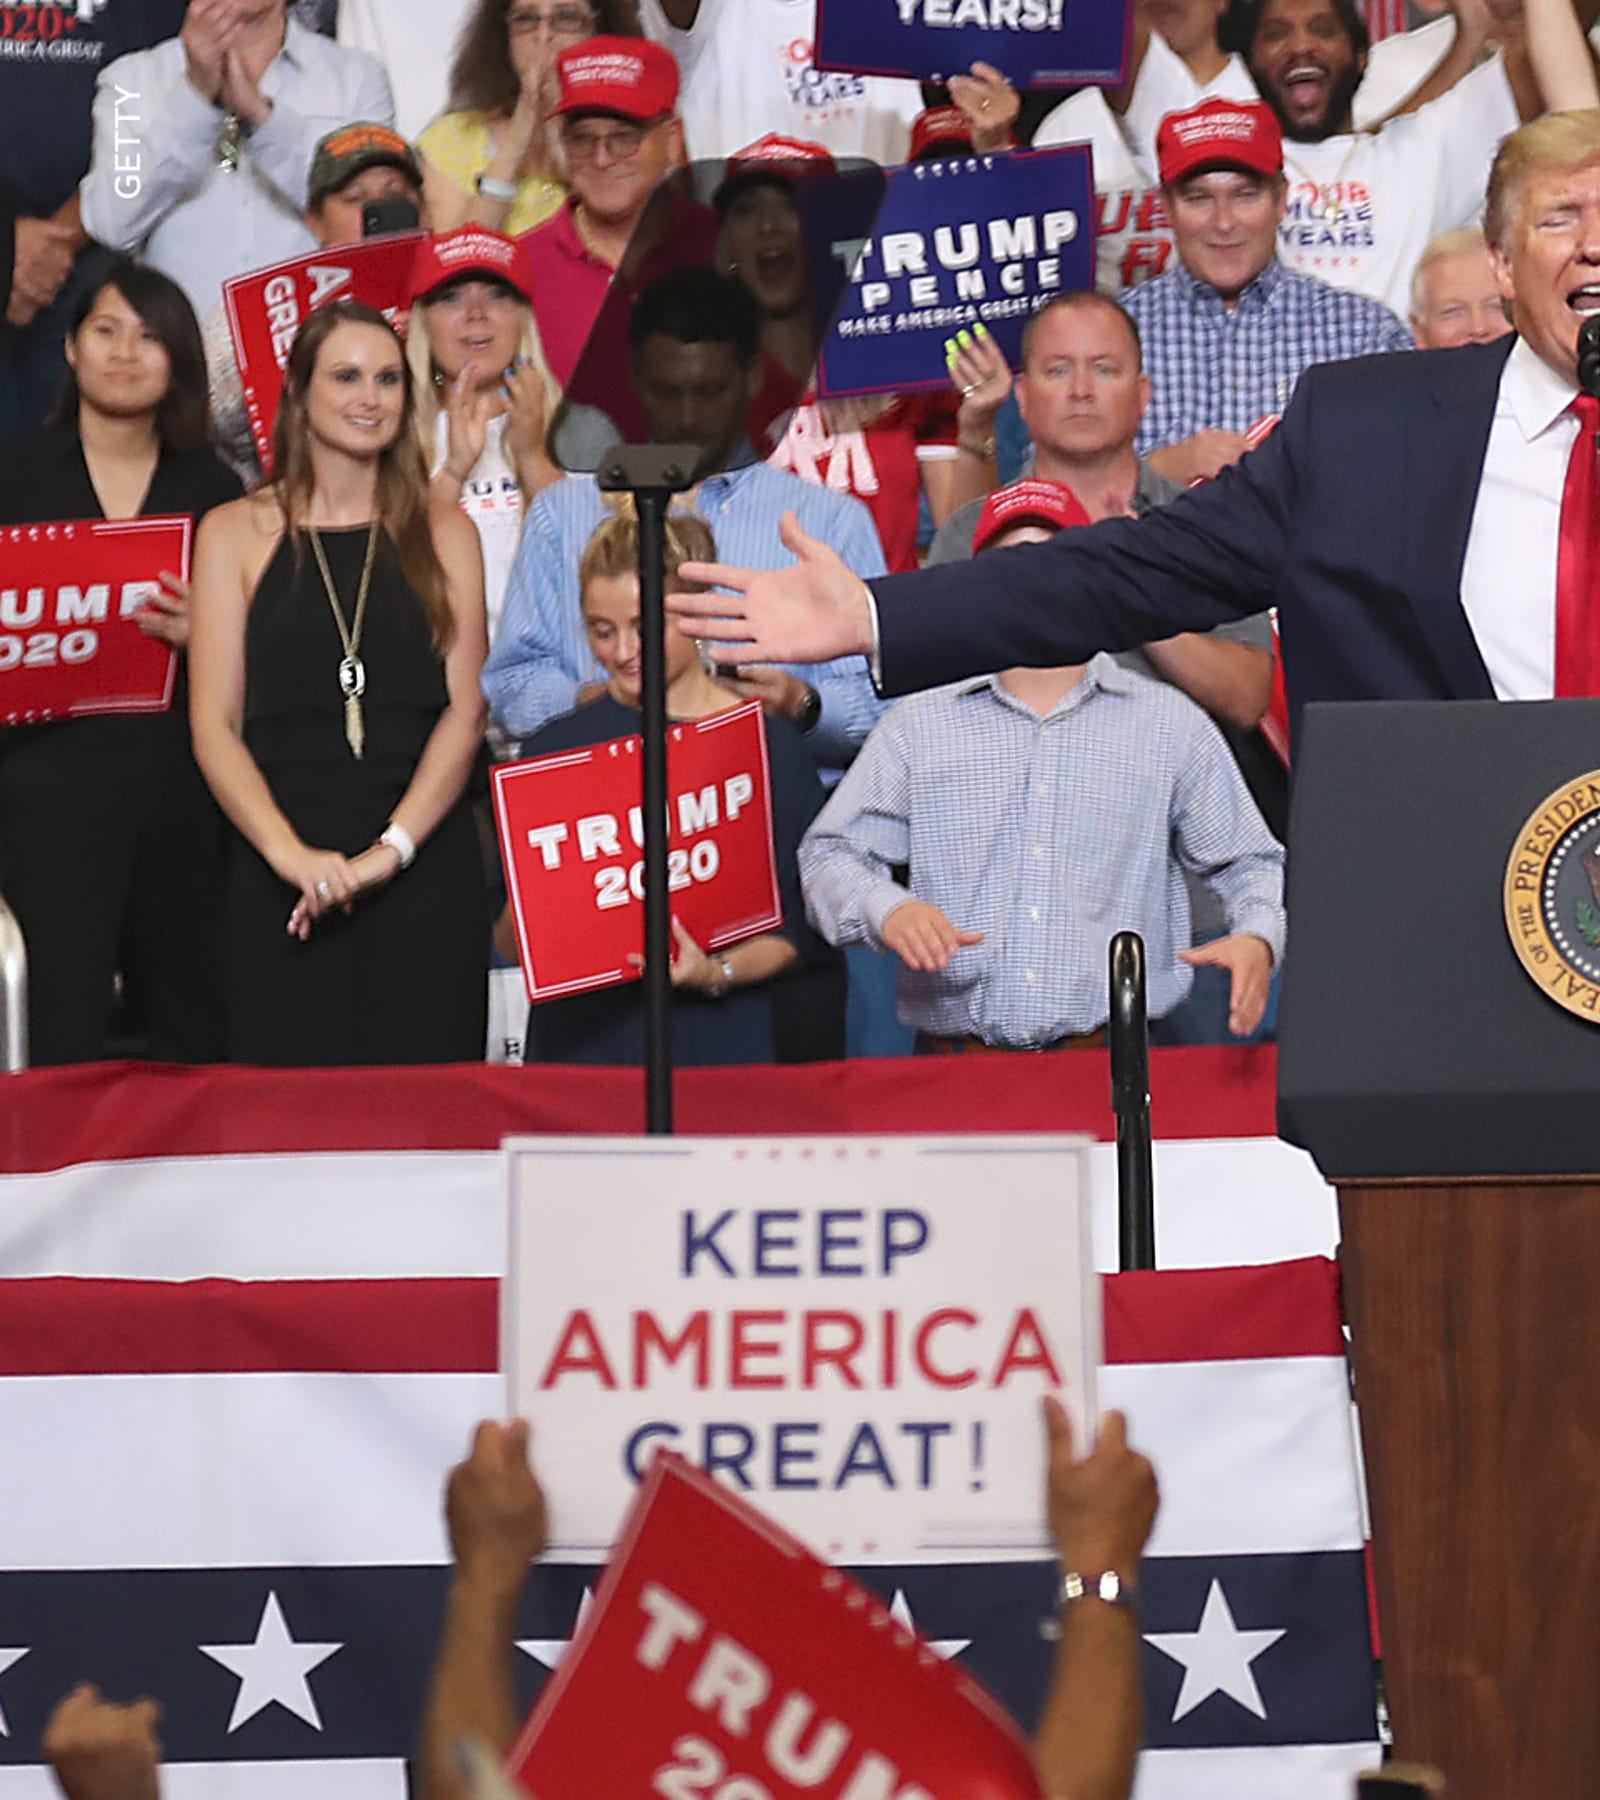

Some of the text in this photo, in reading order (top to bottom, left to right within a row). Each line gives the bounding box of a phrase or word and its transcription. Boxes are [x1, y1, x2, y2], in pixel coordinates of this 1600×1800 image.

[0, 4, 62, 41] 020
[896, 0, 1063, 31] YEARS!
[831, 210, 1079, 284] TRUMP
[860, 258, 1061, 313] PENCE
[264, 275, 302, 370] GRE
[837, 313, 891, 339] MAKE
[893, 304, 978, 333] AMERICA
[979, 296, 1030, 321] GREAT
[0, 580, 162, 630] UMP
[0, 628, 99, 672] 020
[1517, 903, 1539, 937] THE
[1529, 943, 1549, 965] OF
[679, 1208, 932, 1279] KEEP
[538, 1308, 1063, 1392] AMERICA
[622, 1421, 987, 1493] GREAT!
[632, 1582, 938, 1800] TRU
